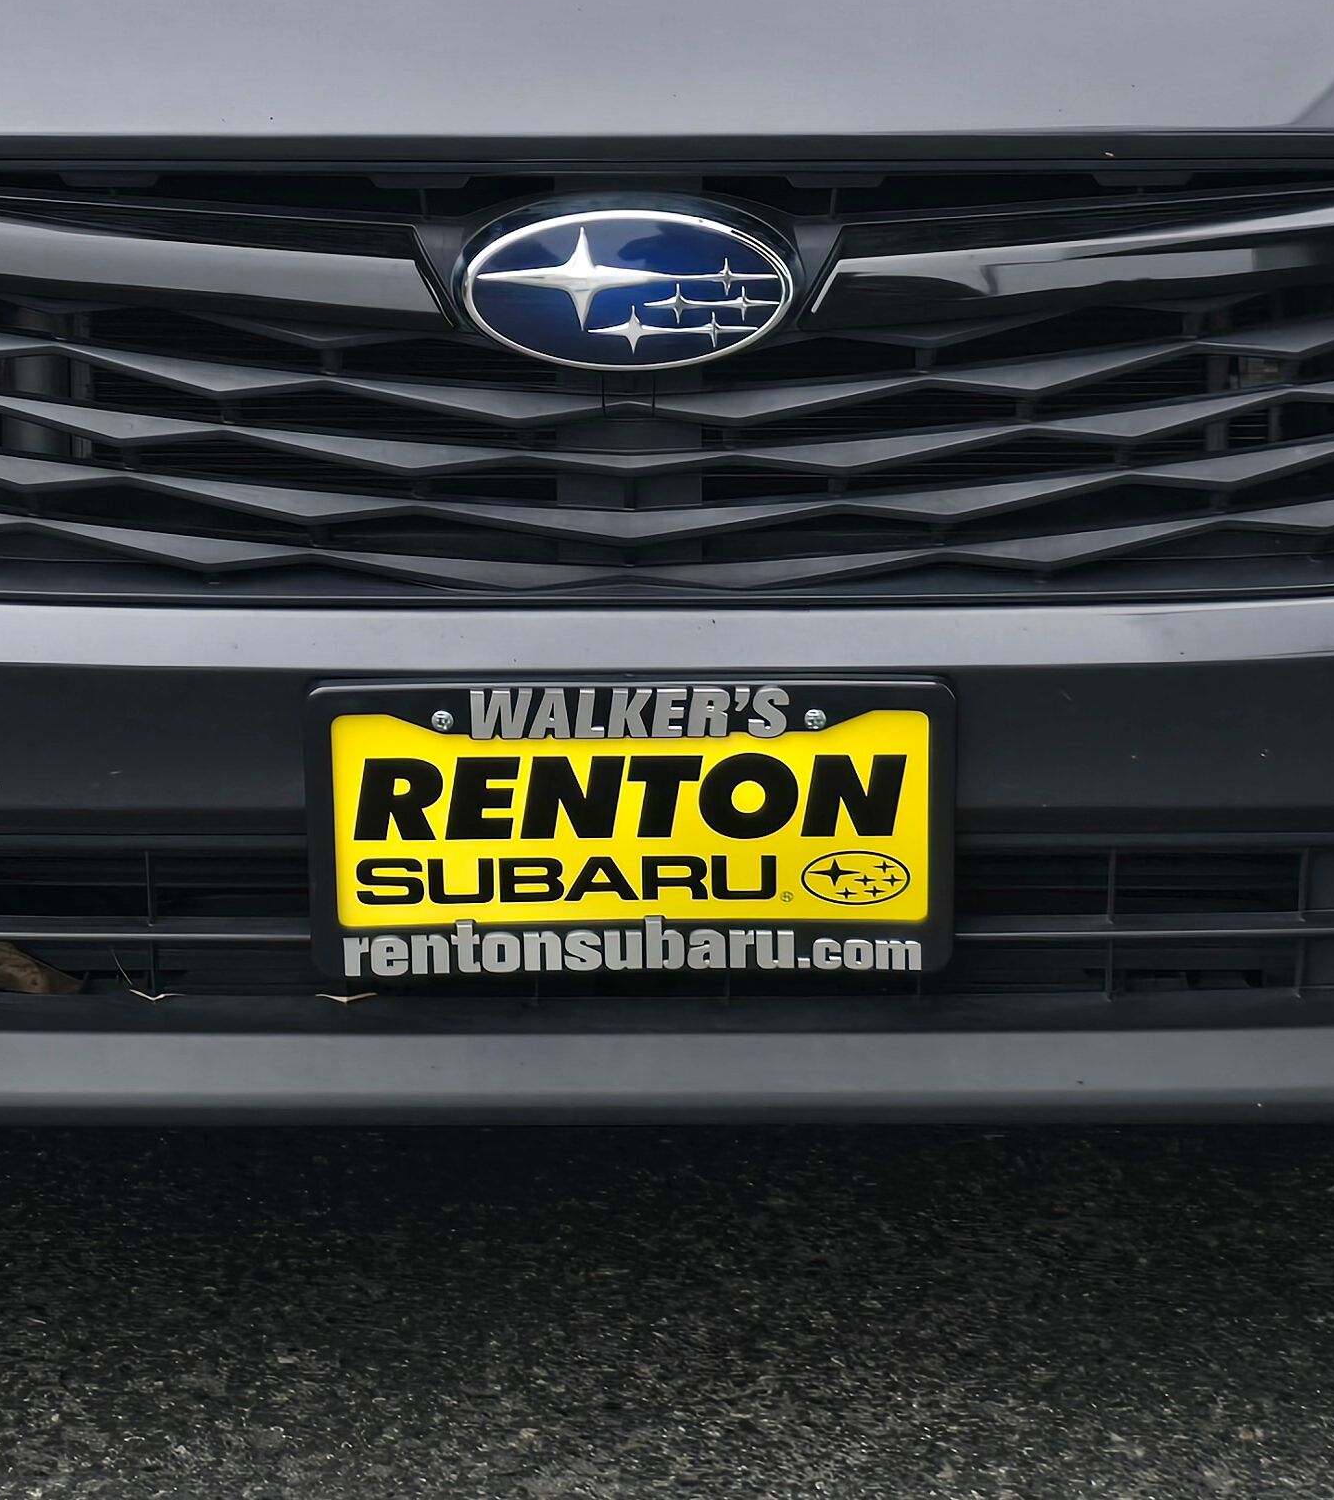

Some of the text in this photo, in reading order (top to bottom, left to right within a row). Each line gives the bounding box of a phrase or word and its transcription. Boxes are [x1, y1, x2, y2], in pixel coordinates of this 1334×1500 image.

[469, 686, 790, 739] WALKER'S
[353, 753, 907, 841] RENTON
[355, 855, 776, 905] SUBARU
[343, 916, 922, 977] rentonsubaru.com
